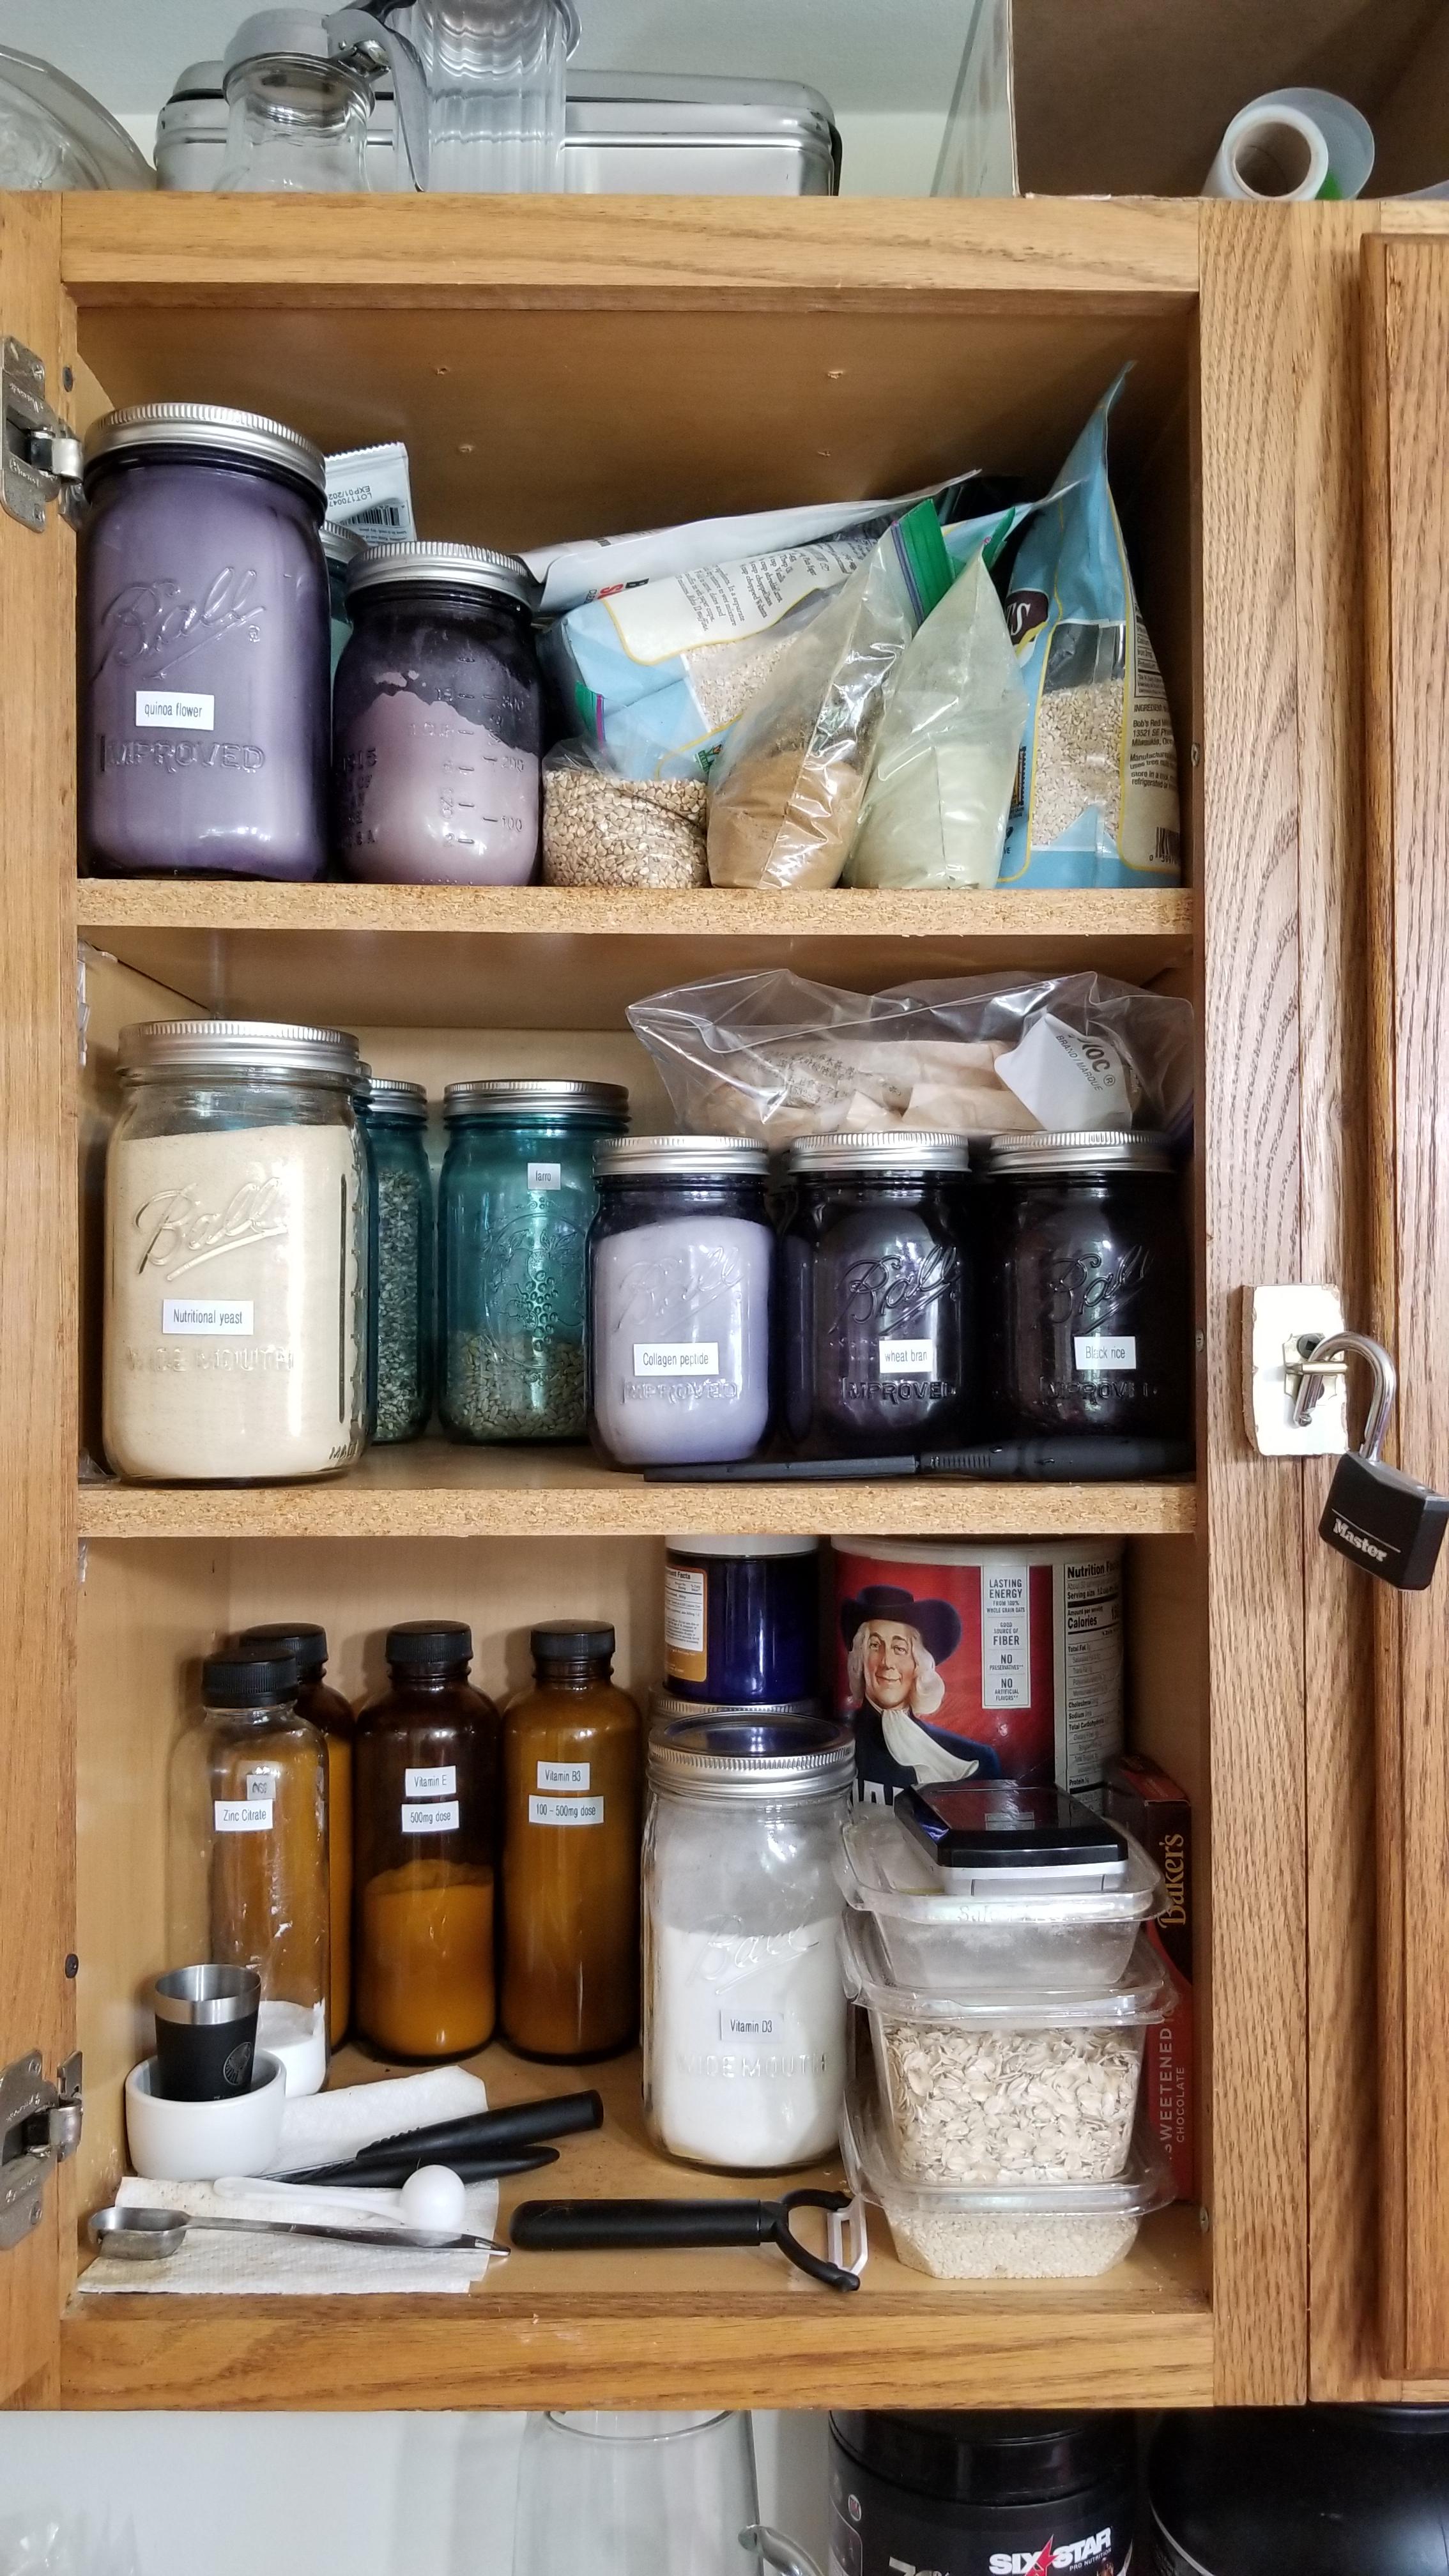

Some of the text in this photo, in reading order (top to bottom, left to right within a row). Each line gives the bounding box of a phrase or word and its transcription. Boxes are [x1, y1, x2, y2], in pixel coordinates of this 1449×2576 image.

[749, 563, 758, 574] cup
[758, 560, 769, 572] cup
[743, 574, 761, 600] chopped
[714, 604, 726, 618] and
[730, 596, 747, 622] separate
[90, 567, 266, 682] Ball
[144, 702, 203, 717] quinoa flower
[1133, 719, 1148, 728] Bob's
[100, 735, 265, 773] IMPROVED
[502, 815, 523, 832] 100
[134, 1177, 289, 1282] Ball
[614, 1246, 744, 1337] Ball
[828, 1245, 960, 1337] Ball
[1044, 1245, 1154, 1337] Ball
[173, 1308, 242, 1326] Nutritional yeast
[643, 1352, 709, 1368] Collagen peptide
[884, 1349, 928, 1362] wheat bran
[1085, 1346, 1126, 1359] Black rice
[622, 1377, 742, 1404] IMPROVED
[1333, 1517, 1388, 1562] Master
[1068, 1563, 1105, 1579] Nutrition
[990, 1579, 1022, 1588] LASTING
[990, 1589, 1023, 1598] ENERGY
[1068, 1591, 1086, 1600] Serving
[1068, 1616, 1097, 1629] Calories
[993, 1636, 1020, 1646] FIBER
[1000, 1654, 1013, 1664] NO
[1001, 1678, 1013, 1689] NO
[414, 1774, 447, 1788] Vitamin E
[544, 1769, 581, 1782] Vitamin B3
[1069, 1777, 1084, 1786] Protein
[224, 1809, 266, 1821] Zinc Citrate
[410, 1811, 451, 1824] 500mg dose
[537, 1803, 596, 1818] 100 500mg dose
[1159, 1834, 1186, 1928] Baker's
[686, 1915, 820, 1995] Ball
[730, 2019, 772, 2033] Vitamin D3
[742, 2054, 827, 2078] MOUTH
[1176, 2067, 1184, 2143] CHOCOLATE
[989, 2551, 1043, 2575] SIX
[1052, 2527, 1112, 2568] STAR
[1070, 2547, 1112, 2572] PRO NUTRITION
